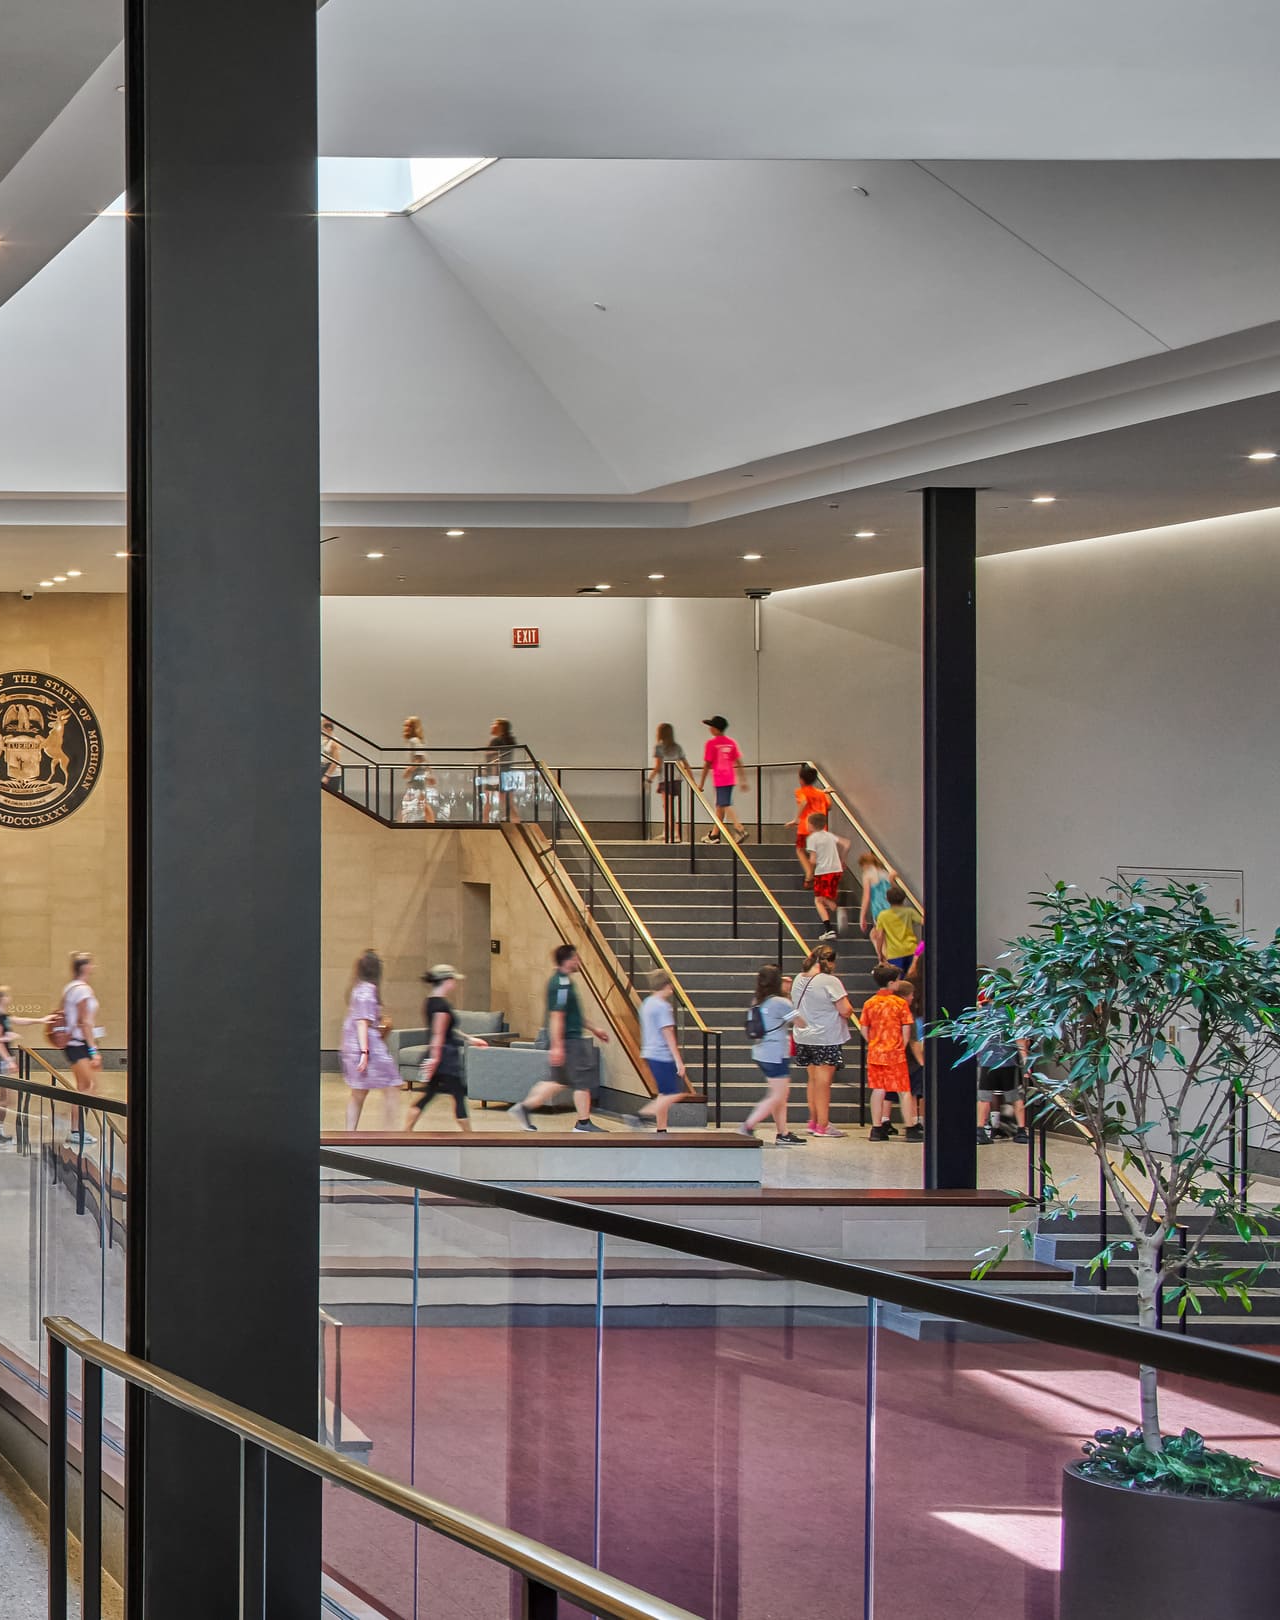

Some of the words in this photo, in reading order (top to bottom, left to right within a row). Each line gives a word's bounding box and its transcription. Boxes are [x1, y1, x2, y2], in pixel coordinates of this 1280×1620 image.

[516, 629, 536, 644] EXIT
[12, 674, 38, 684] THE
[44, 679, 78, 704] STATE
[79, 707, 92, 722] OF
[81, 729, 100, 791] MICHIGAN
[7, 1004, 42, 1013] 2022
